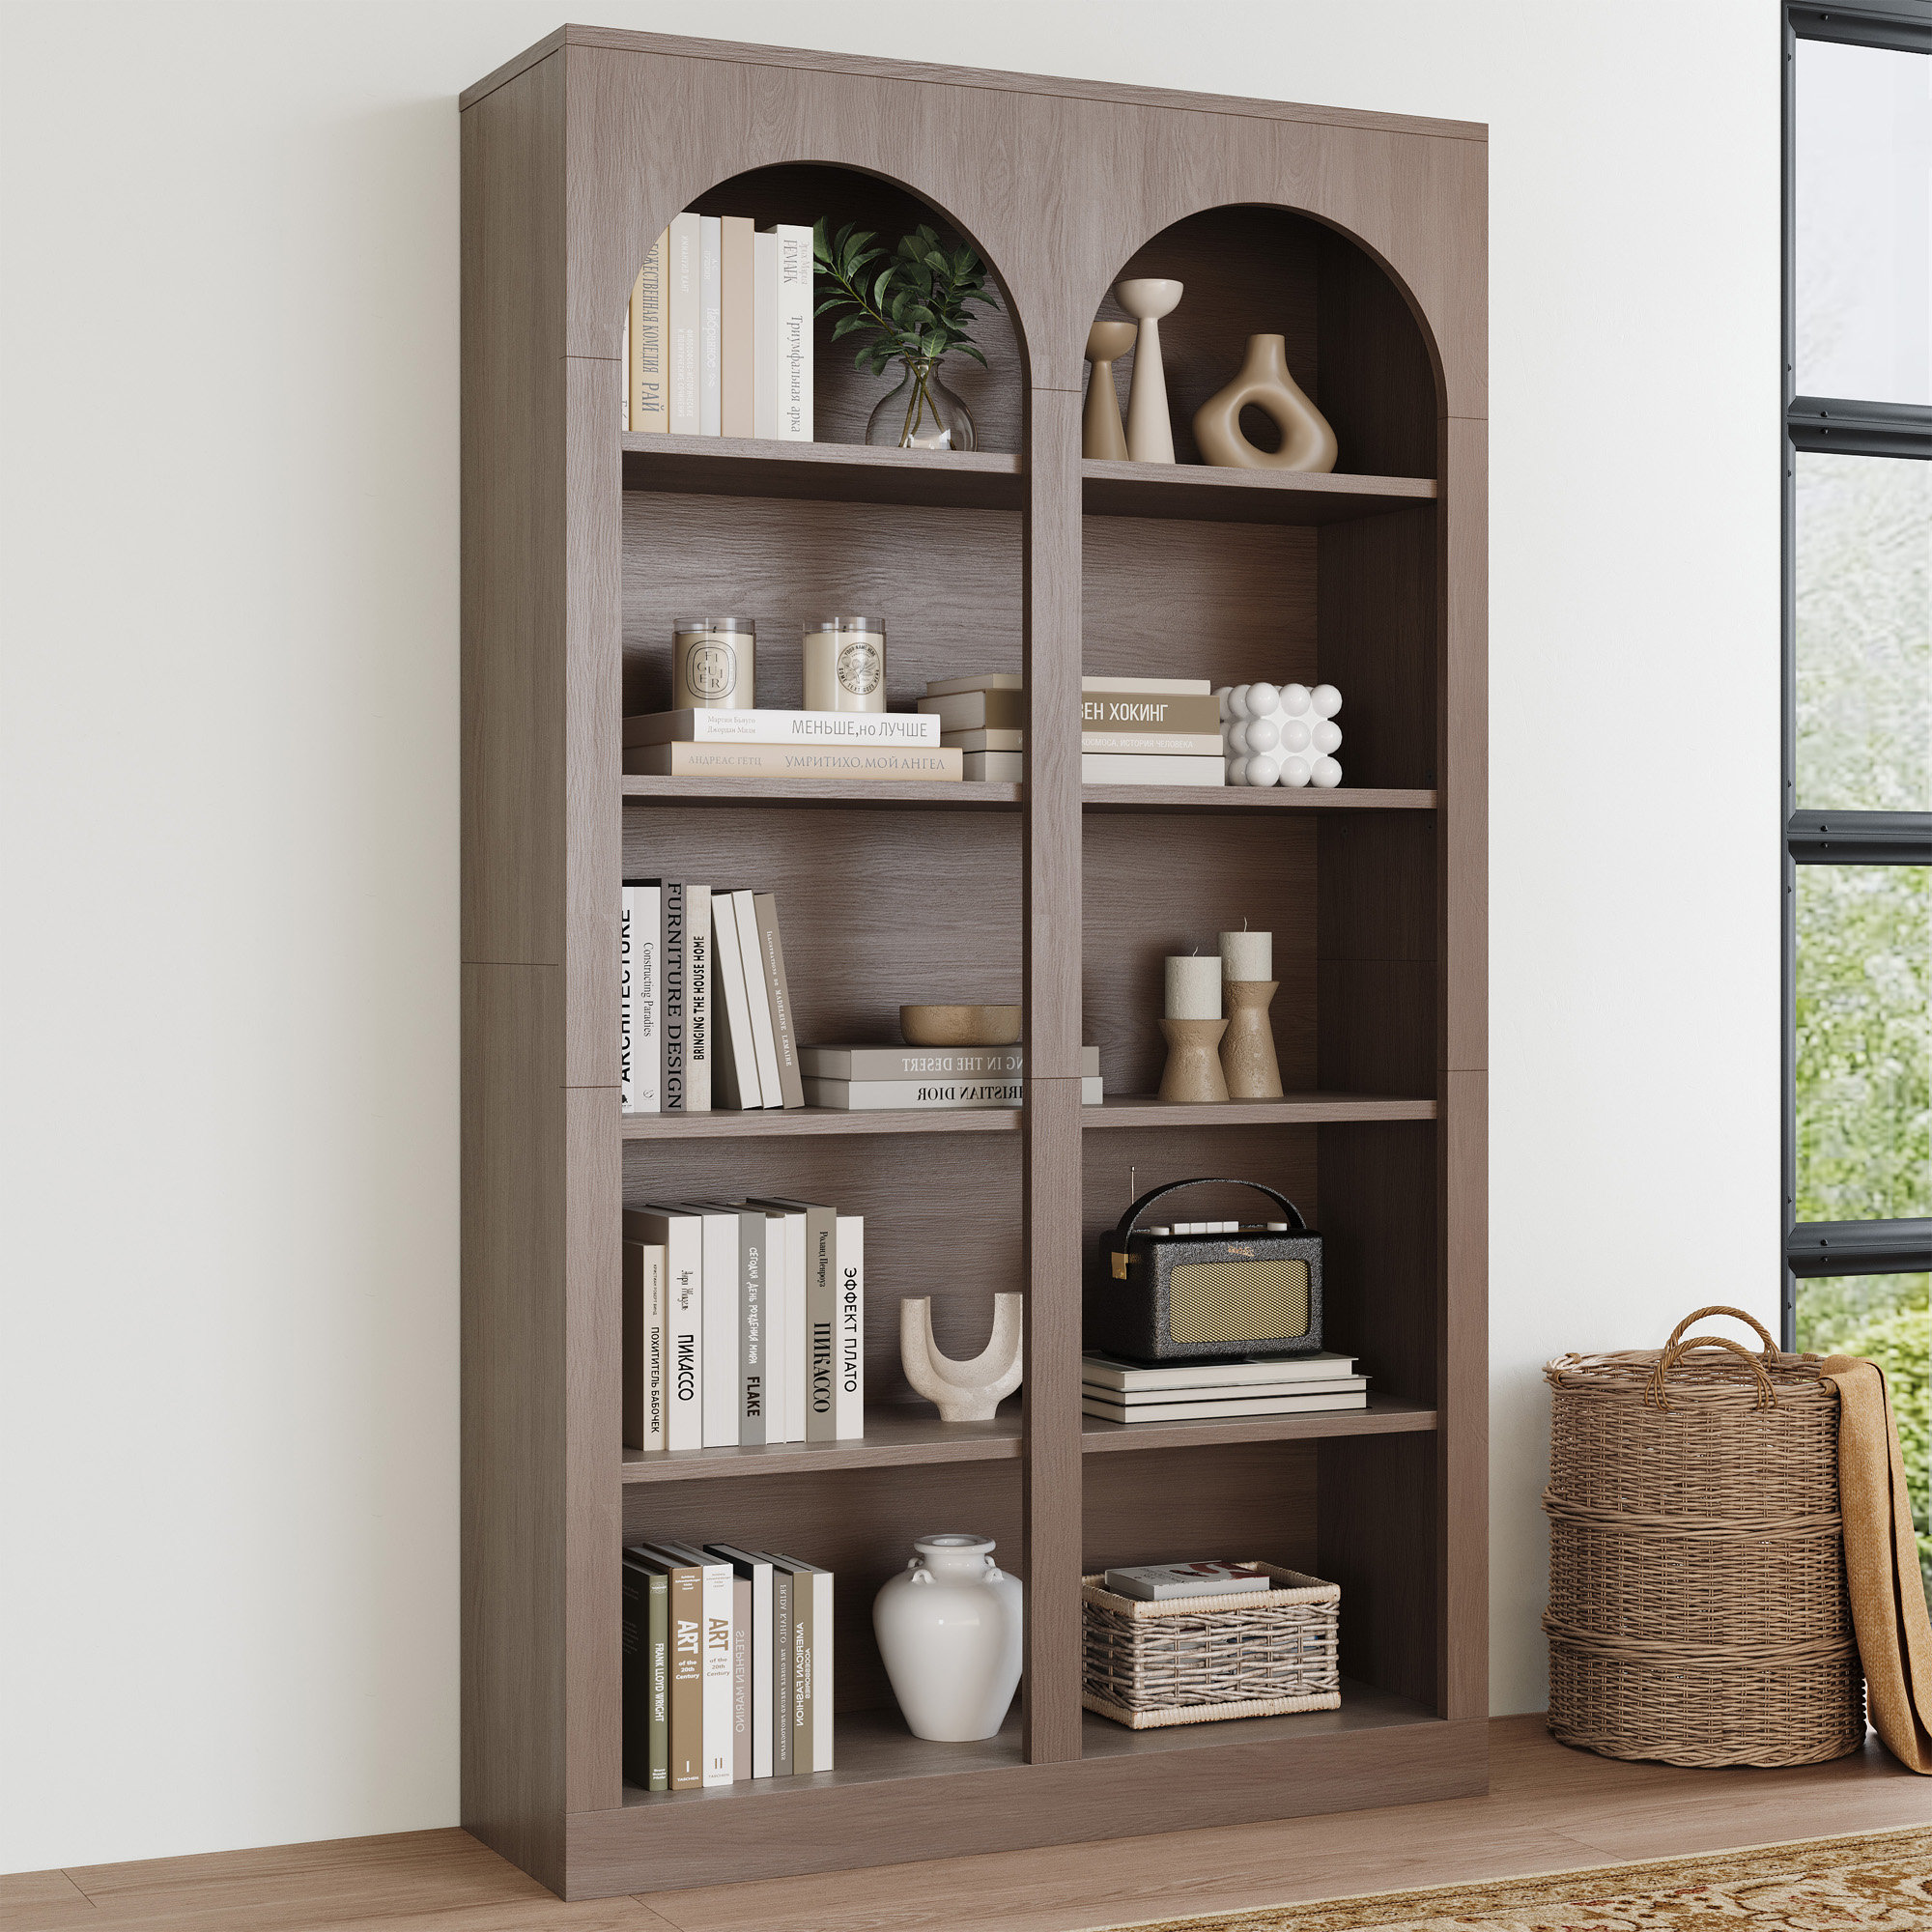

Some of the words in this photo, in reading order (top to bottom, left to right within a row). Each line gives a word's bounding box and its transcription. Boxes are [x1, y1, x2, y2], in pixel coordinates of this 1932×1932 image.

[783, 240, 798, 284] РЕМАРК
[640, 325, 660, 374] КОМЕДИЯ
[785, 315, 805, 402] Триумфальная
[641, 382, 665, 413] РАЙ
[786, 406, 801, 433] арка
[878, 721, 928, 738] ЛУЧШЕ
[1109, 702, 1169, 723] ХОКИНГ
[688, 755, 734, 766] АНДРЕАС
[901, 758, 946, 770] АНГЕЛ
[668, 882, 682, 1017] FURNITURE
[693, 936, 705, 961] HOME
[640, 942, 655, 997] Constructing
[693, 964, 705, 994] HOUSE
[693, 996, 705, 1014] THE
[693, 1017, 705, 1061] BRINGING
[775, 989, 787, 1032] MADELEINE
[781, 1034, 792, 1067] LEMAIRE
[668, 1024, 682, 1110] DESIGN
[748, 1247, 759, 1279] СЕГОДНЯ
[746, 1282, 759, 1303] ДЕНЬ
[843, 1267, 858, 1333] ЭФФЕКТ
[747, 1304, 759, 1342] РОЖДЕНИЯ
[650, 1326, 660, 1388] ПОХИТИТЕЛЬ
[677, 1334, 695, 1401] ПИКАССО
[748, 1344, 759, 1364] МИРА
[812, 1321, 832, 1413] ПИКАССО
[843, 1338, 858, 1393] ПЛАТО
[650, 1390, 660, 1433] БАБОЧЕК
[747, 1377, 760, 1417] FLAKE
[677, 1620, 698, 1655] ART
[708, 1618, 729, 1651] ART
[655, 1643, 665, 1667] FRANK
[655, 1667, 665, 1691] LLOYD
[655, 1691, 665, 1722] WRIGHT
